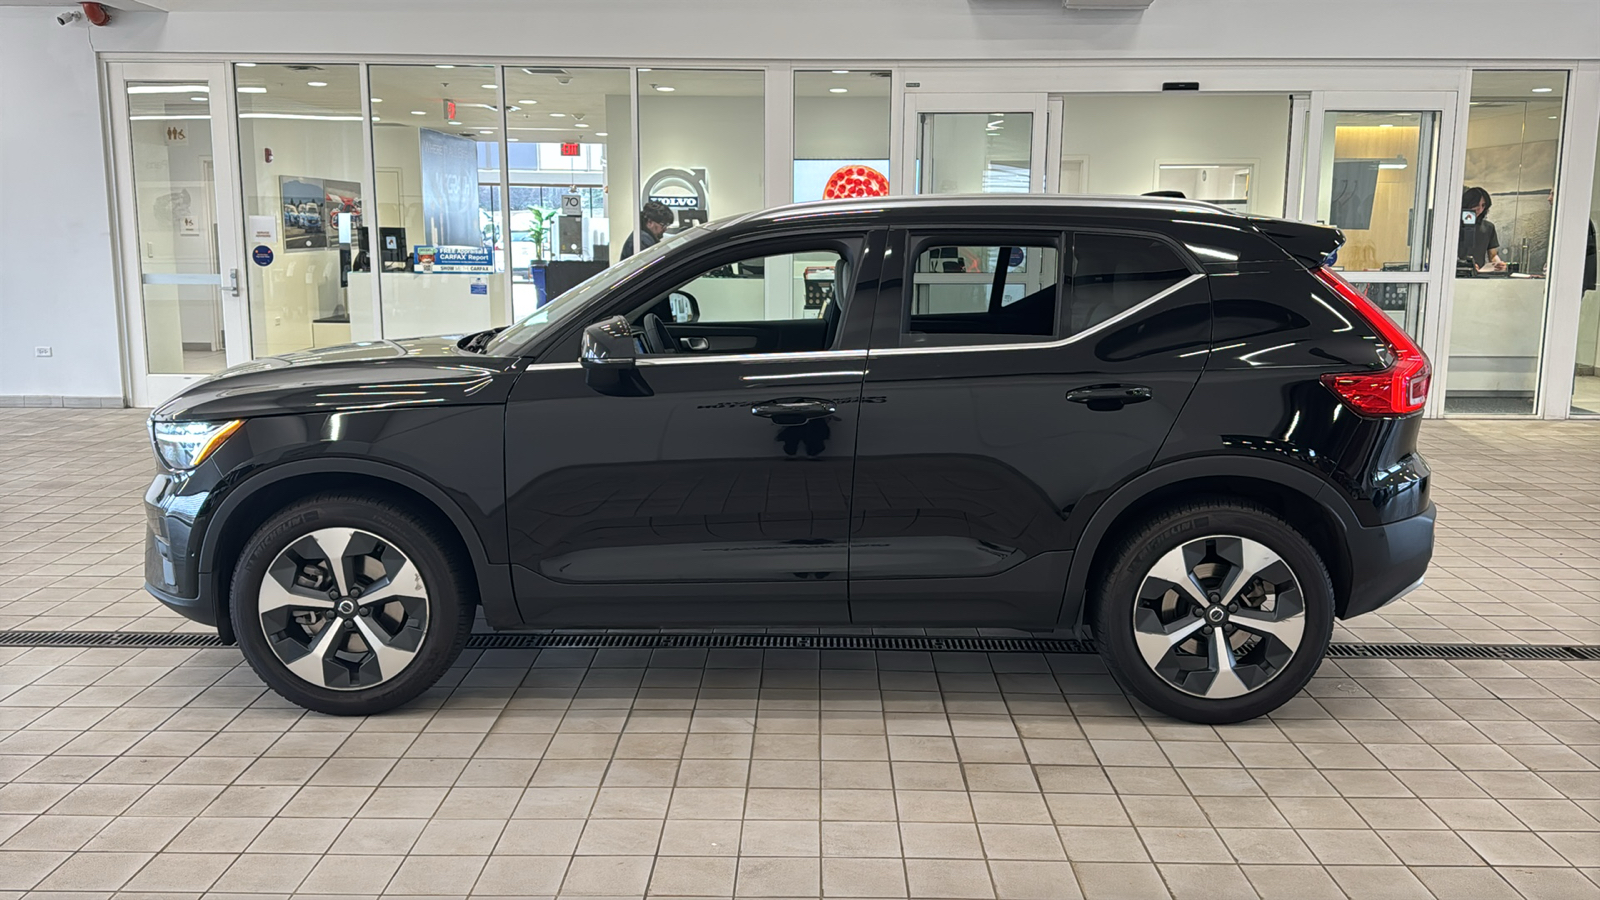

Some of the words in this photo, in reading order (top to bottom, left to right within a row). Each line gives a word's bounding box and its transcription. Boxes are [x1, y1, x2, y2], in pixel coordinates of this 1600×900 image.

[563, 143, 579, 155] EXIT
[564, 197, 579, 207] 70
[253, 513, 303, 559] MICHELIN
[1137, 519, 1193, 561] MICHELIN
